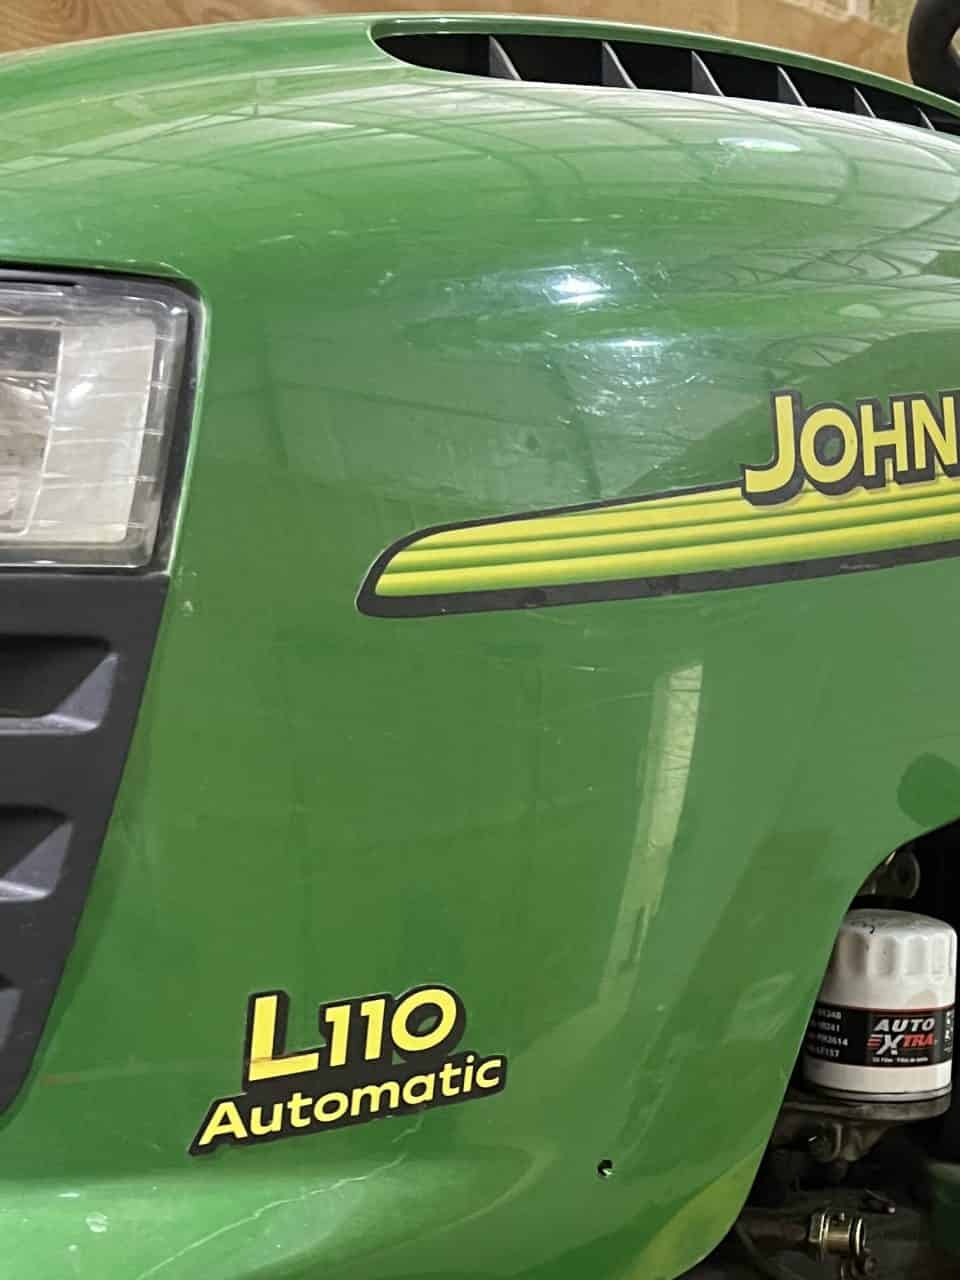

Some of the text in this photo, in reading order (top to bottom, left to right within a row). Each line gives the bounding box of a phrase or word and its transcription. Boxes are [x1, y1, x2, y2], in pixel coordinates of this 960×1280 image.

[248, 986, 458, 1082] L110
[866, 1033, 935, 1055] EXTRA
[874, 1018, 936, 1033] AUTO
[197, 1055, 503, 1146] Automatic
